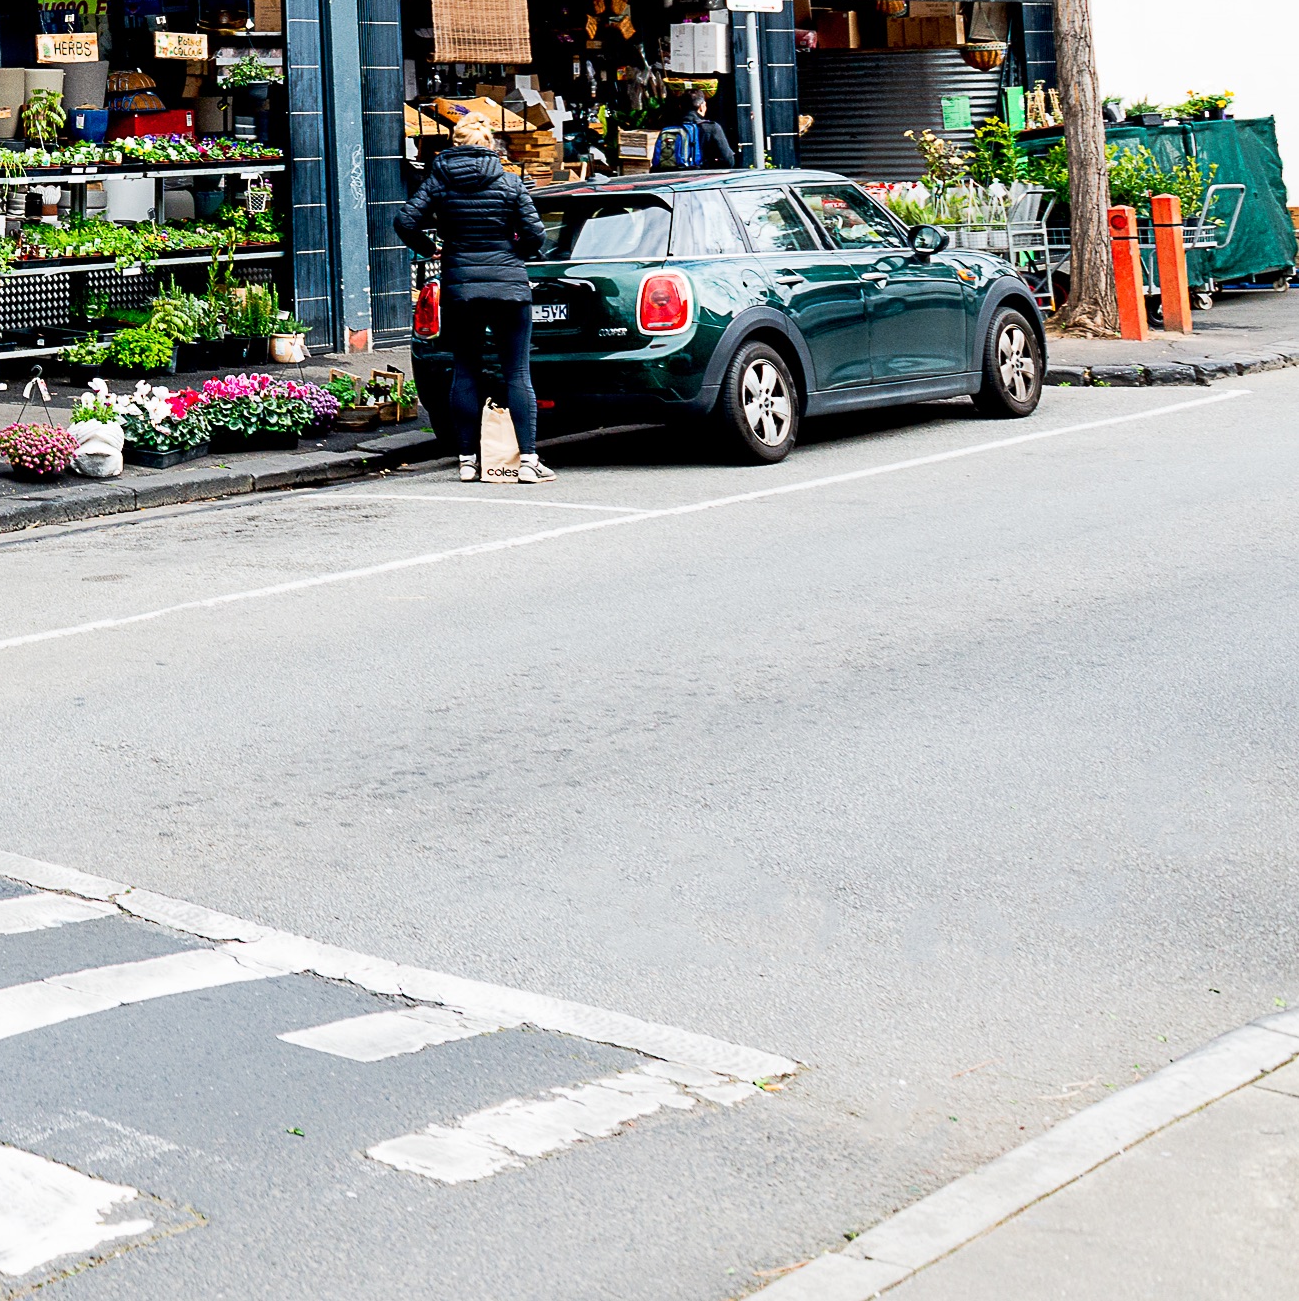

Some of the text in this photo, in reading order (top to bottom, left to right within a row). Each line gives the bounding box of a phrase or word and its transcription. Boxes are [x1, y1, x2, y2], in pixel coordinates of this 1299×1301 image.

[53, 41, 92, 57] HERBS
[173, 45, 203, 57] COLOUR
[598, 327, 628, 337] COOPER
[487, 467, 519, 478] coles
